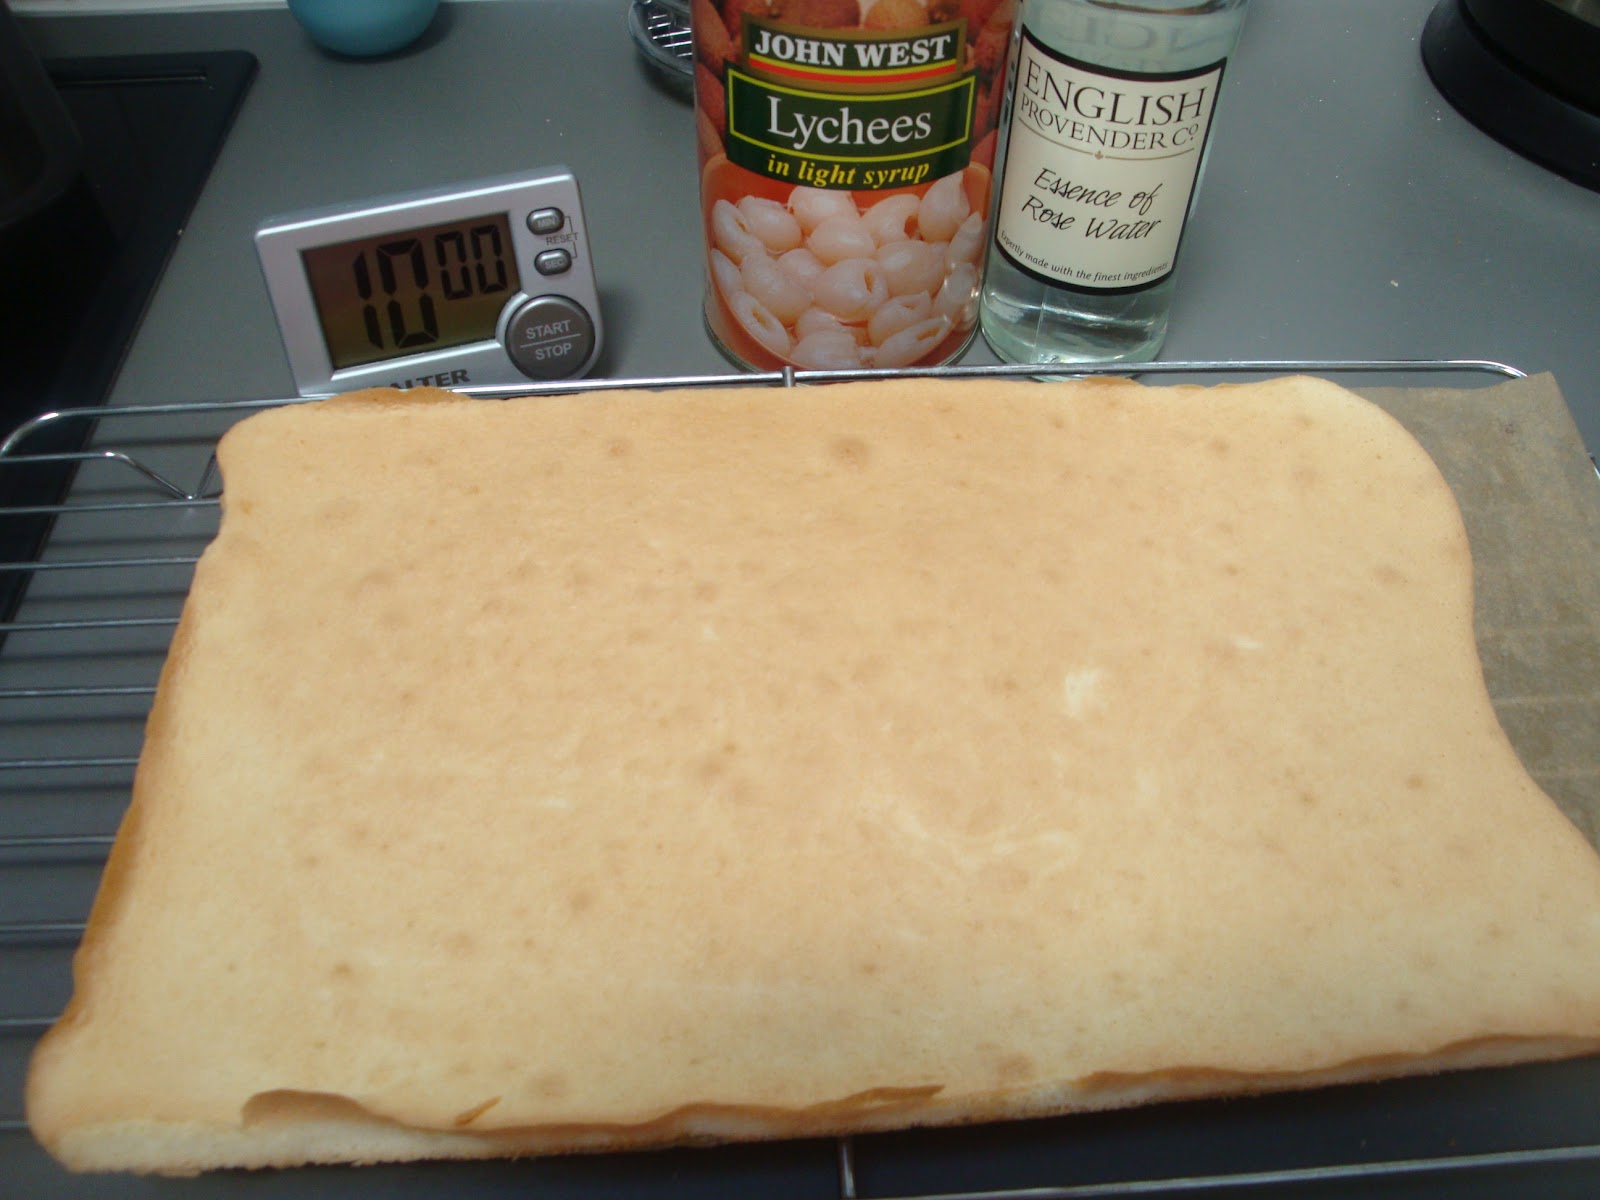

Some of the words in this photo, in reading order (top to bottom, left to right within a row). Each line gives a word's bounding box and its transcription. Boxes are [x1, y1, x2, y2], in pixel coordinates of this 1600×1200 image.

[755, 30, 847, 67] JOHN
[854, 35, 951, 68] WEST
[1024, 57, 1208, 127] ENGLISH
[767, 95, 932, 150] Lychees
[1021, 93, 1167, 151] PROVENDER
[767, 154, 790, 176] in
[798, 162, 857, 188] light
[863, 163, 930, 189] syrup
[1034, 167, 1121, 208] Essence
[1129, 182, 1163, 216] of
[1021, 194, 1075, 231] Rose
[1085, 217, 1162, 240] Water
[546, 232, 578, 245] RESET
[1025, 253, 1049, 269] made
[1051, 265, 1073, 277] with
[1076, 270, 1092, 280] the
[1093, 271, 1121, 282] finest
[526, 319, 571, 340] START
[535, 342, 573, 361] STOP
